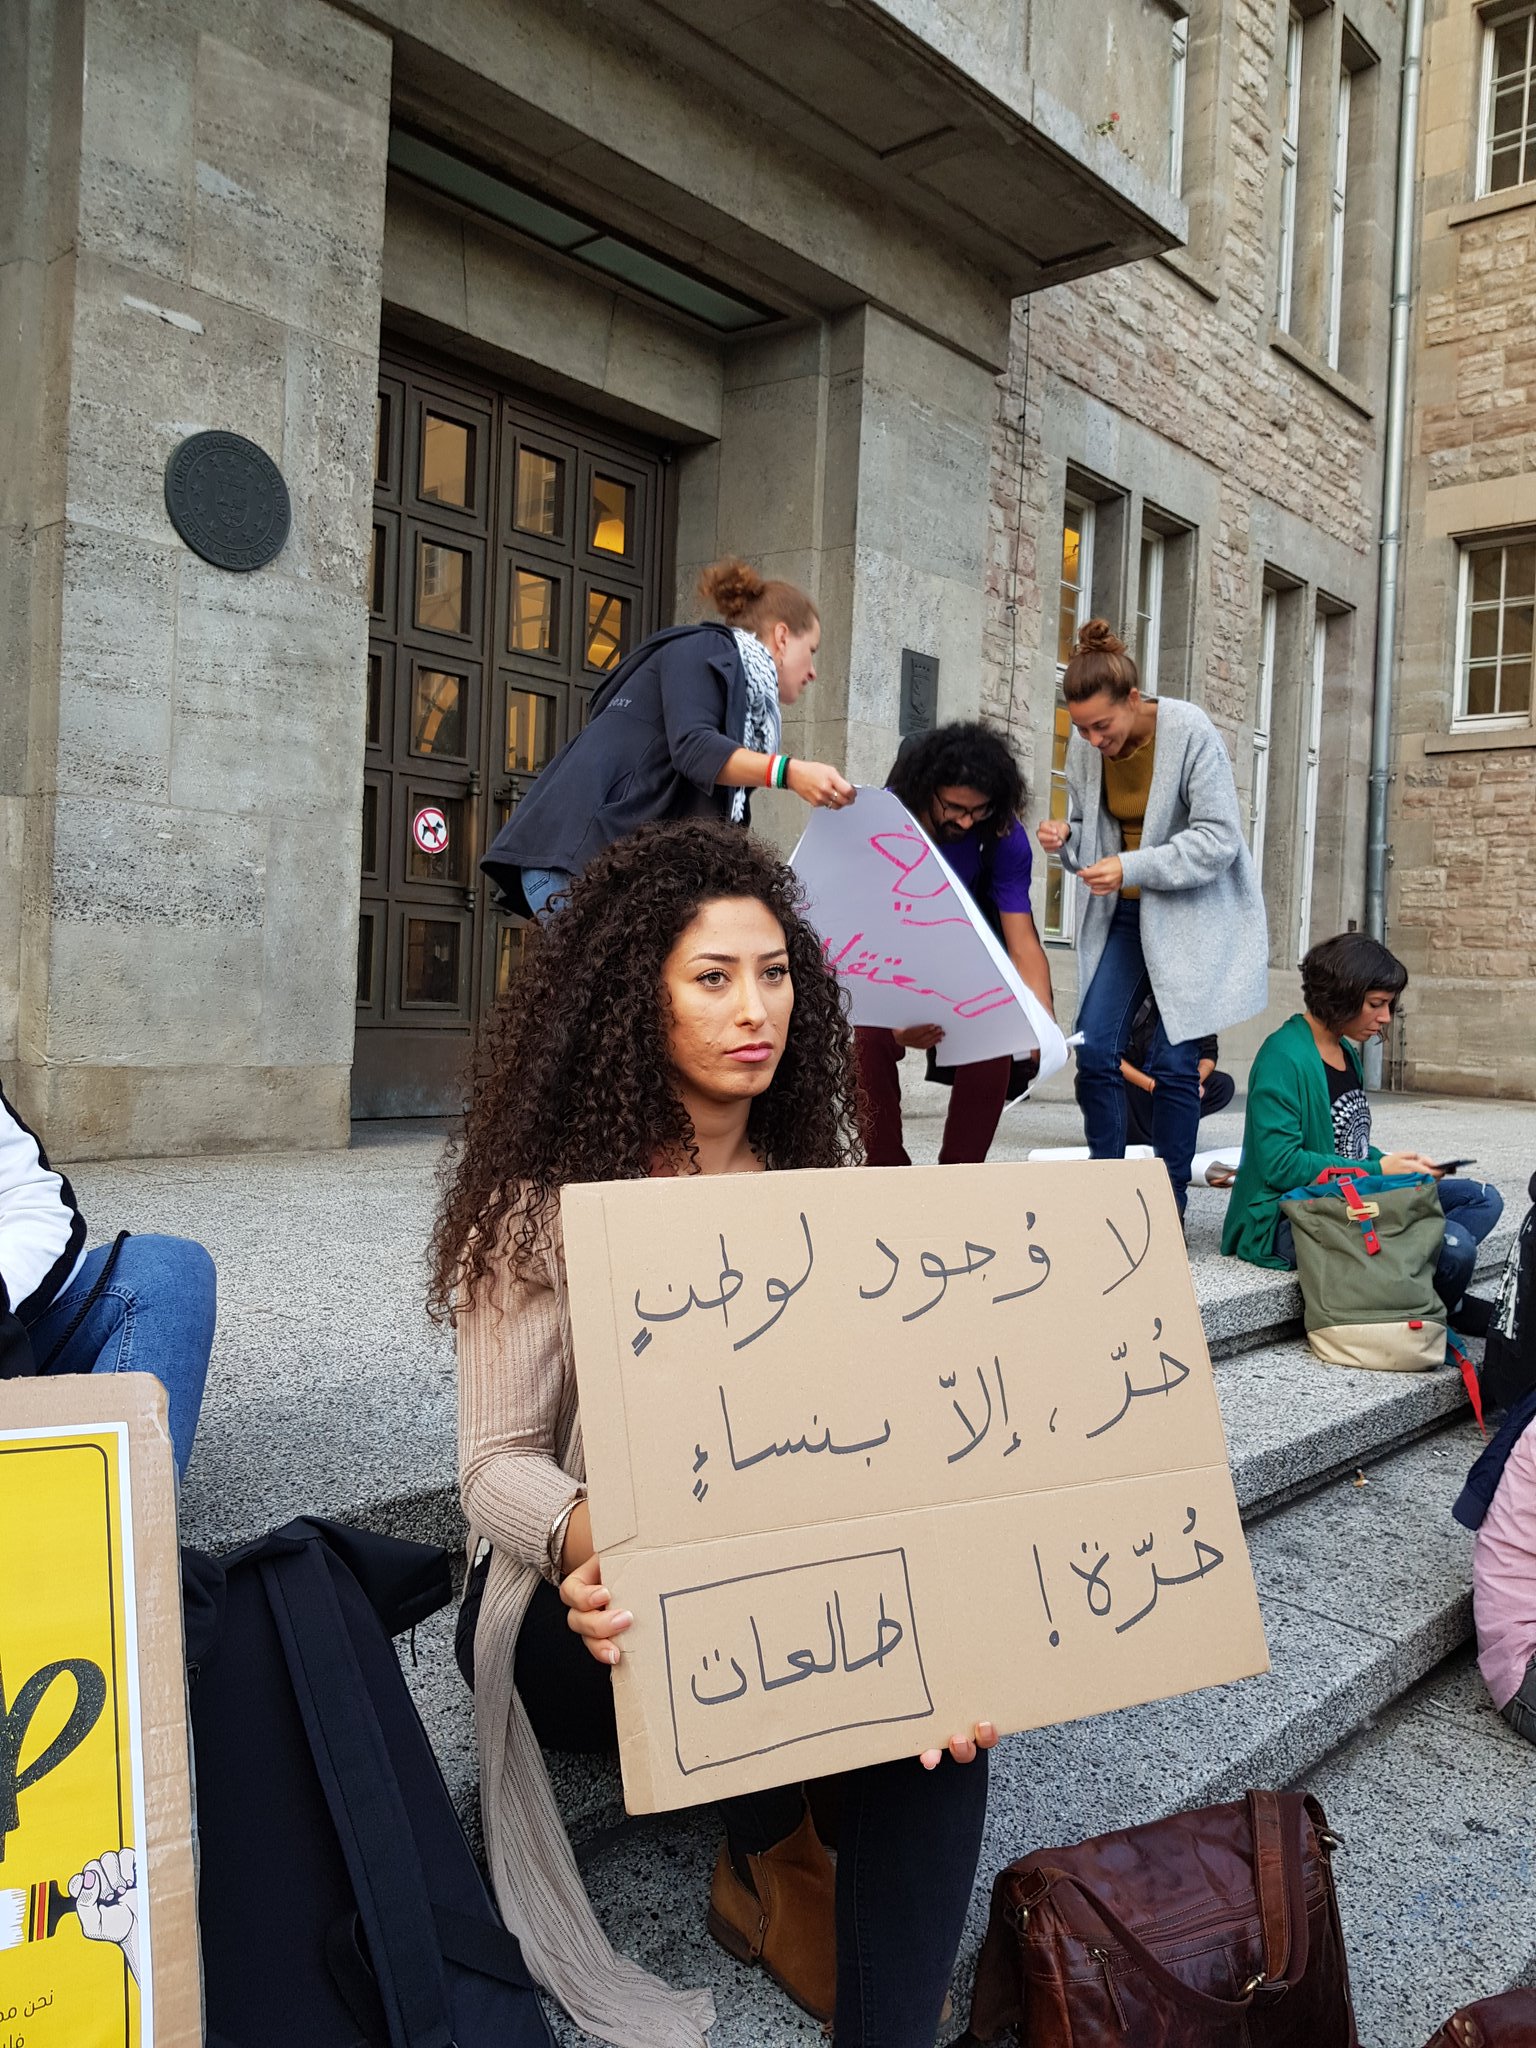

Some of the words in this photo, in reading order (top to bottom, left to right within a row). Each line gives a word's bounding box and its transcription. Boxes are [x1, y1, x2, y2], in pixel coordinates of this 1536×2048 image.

[1102, 1188, 1151, 1296] لا
[691, 1590, 903, 1706] طالعات
[24, 1989, 53, 2018] نحن
